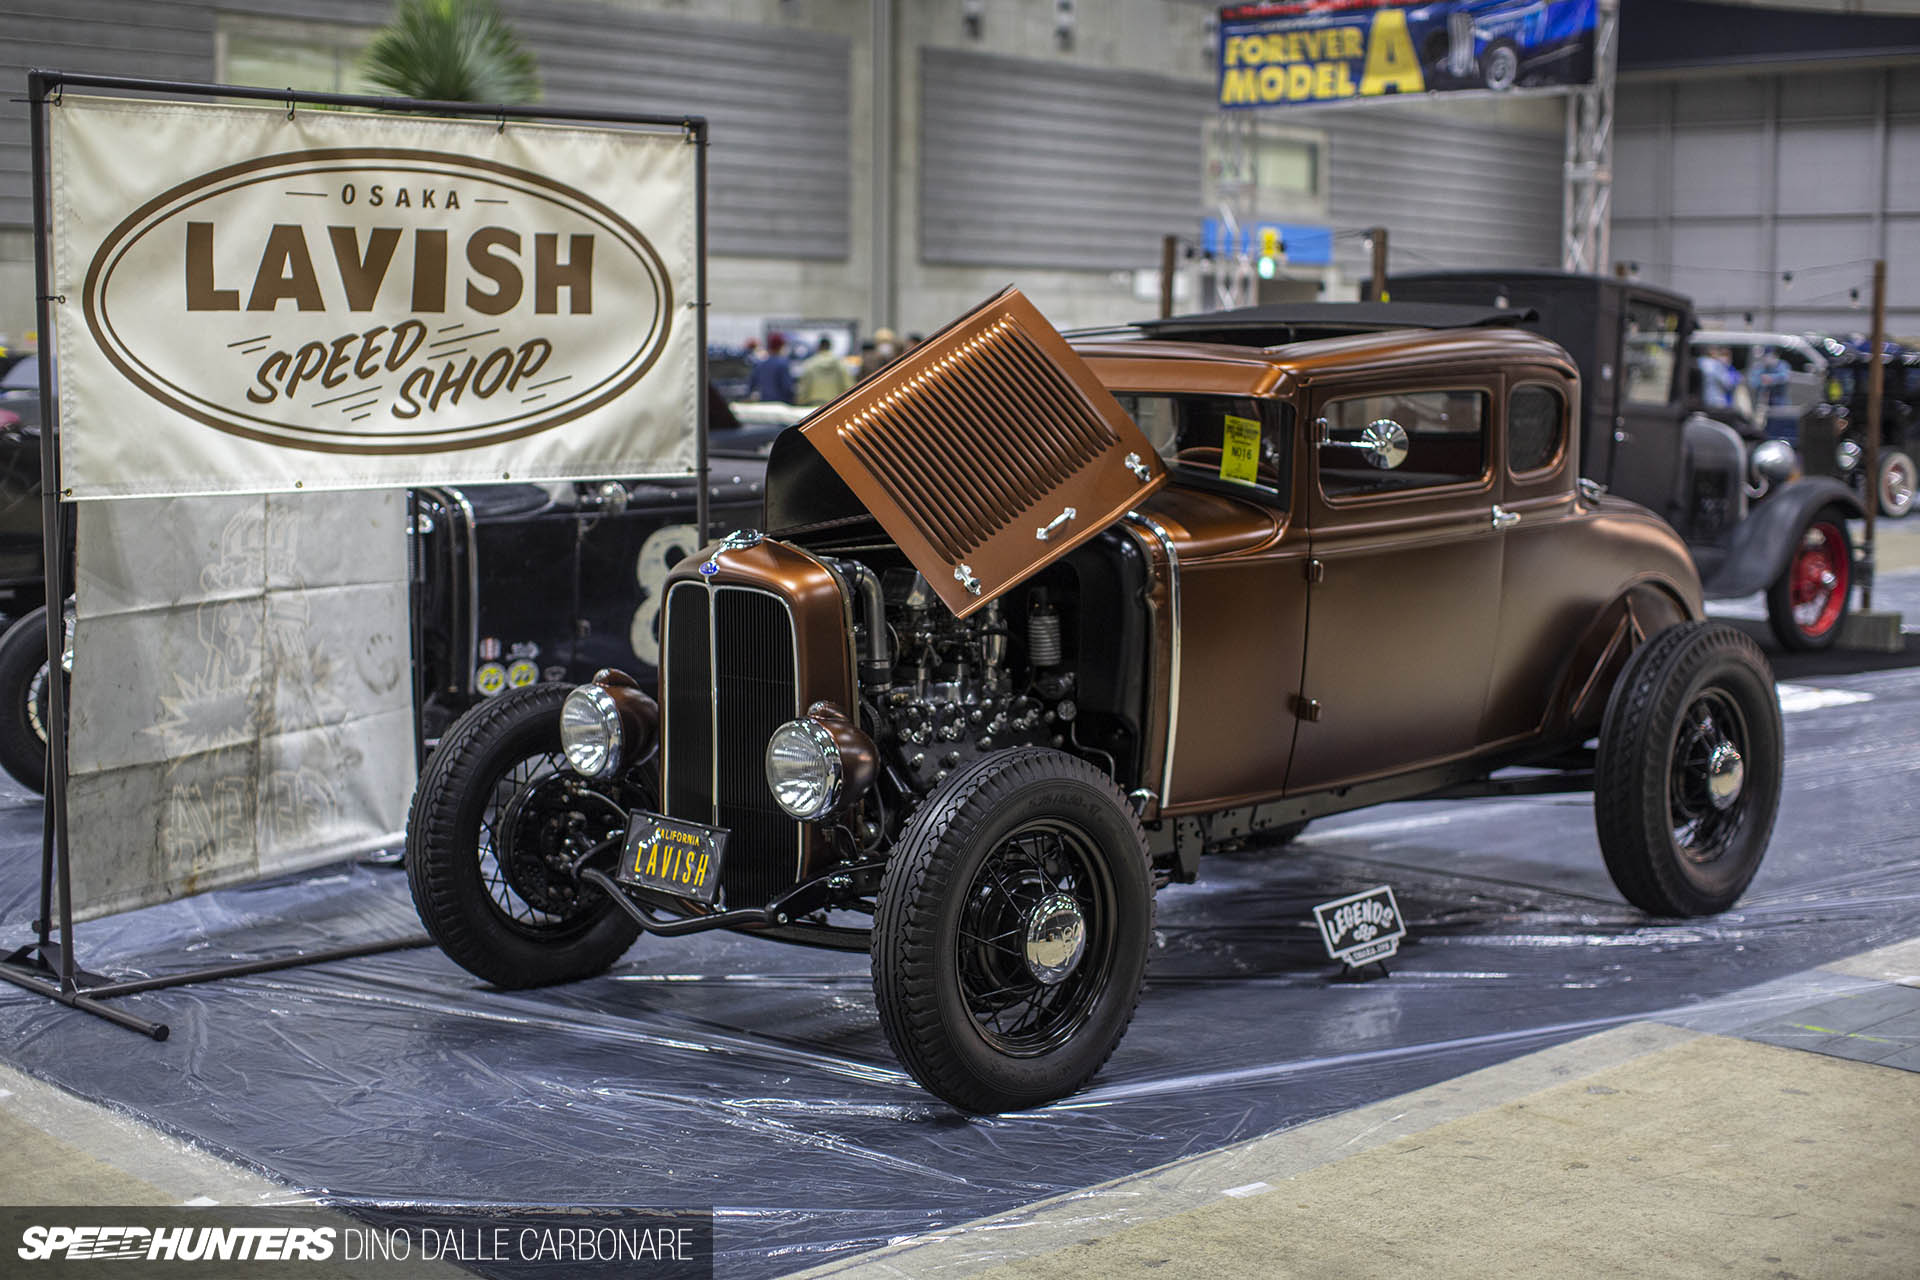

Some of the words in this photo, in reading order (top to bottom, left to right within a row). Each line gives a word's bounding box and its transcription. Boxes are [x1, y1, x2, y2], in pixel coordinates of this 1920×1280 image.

[1222, 63, 1356, 104] MODEL
[1359, 9, 1426, 95] A
[1225, 27, 1364, 67] FOREVER
[342, 183, 461, 210] OSAKA
[186, 221, 595, 316] LAVISH
[246, 320, 427, 404] SPEED
[391, 338, 552, 419] SHOP
[634, 843, 709, 887] LAVISH
